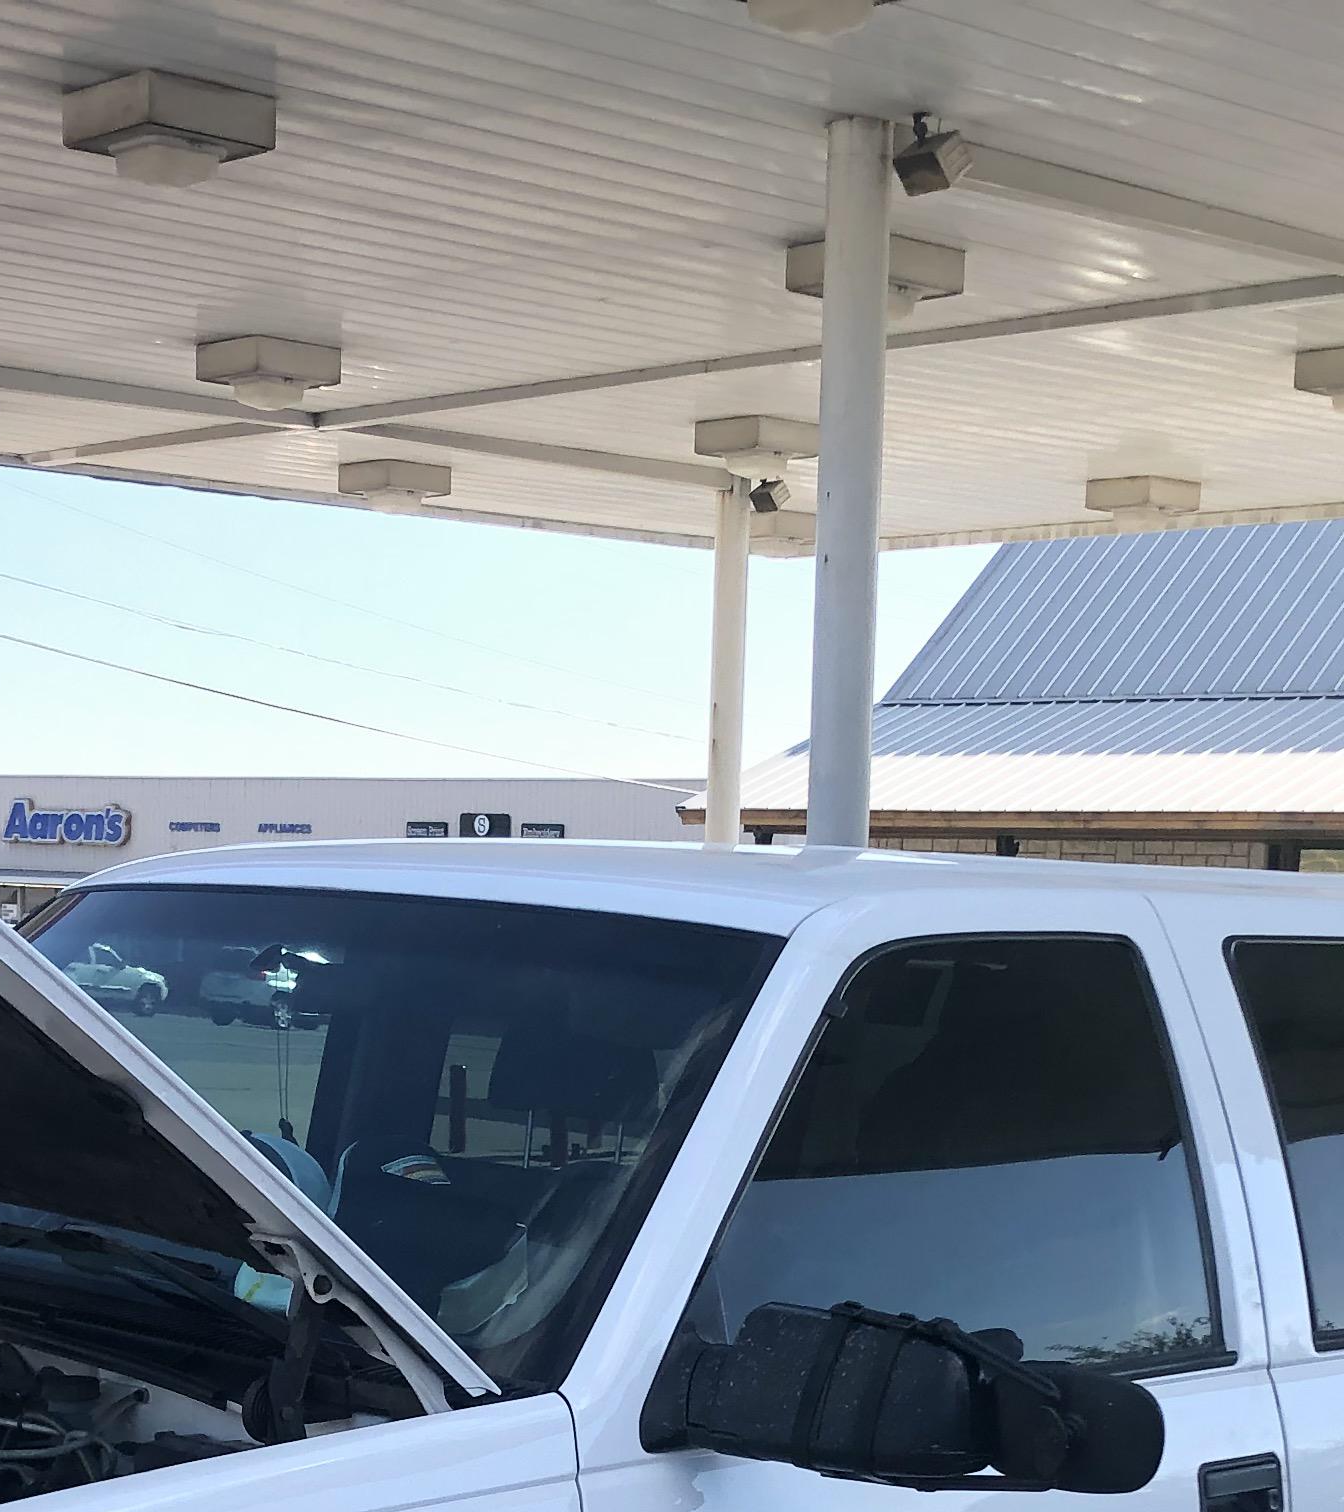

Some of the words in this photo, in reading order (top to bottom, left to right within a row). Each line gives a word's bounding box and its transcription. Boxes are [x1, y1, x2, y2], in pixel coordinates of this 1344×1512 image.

[3, 800, 125, 844] Aaron's
[257, 823, 312, 834] APPLIANCES
[477, 817, 487, 833] S
